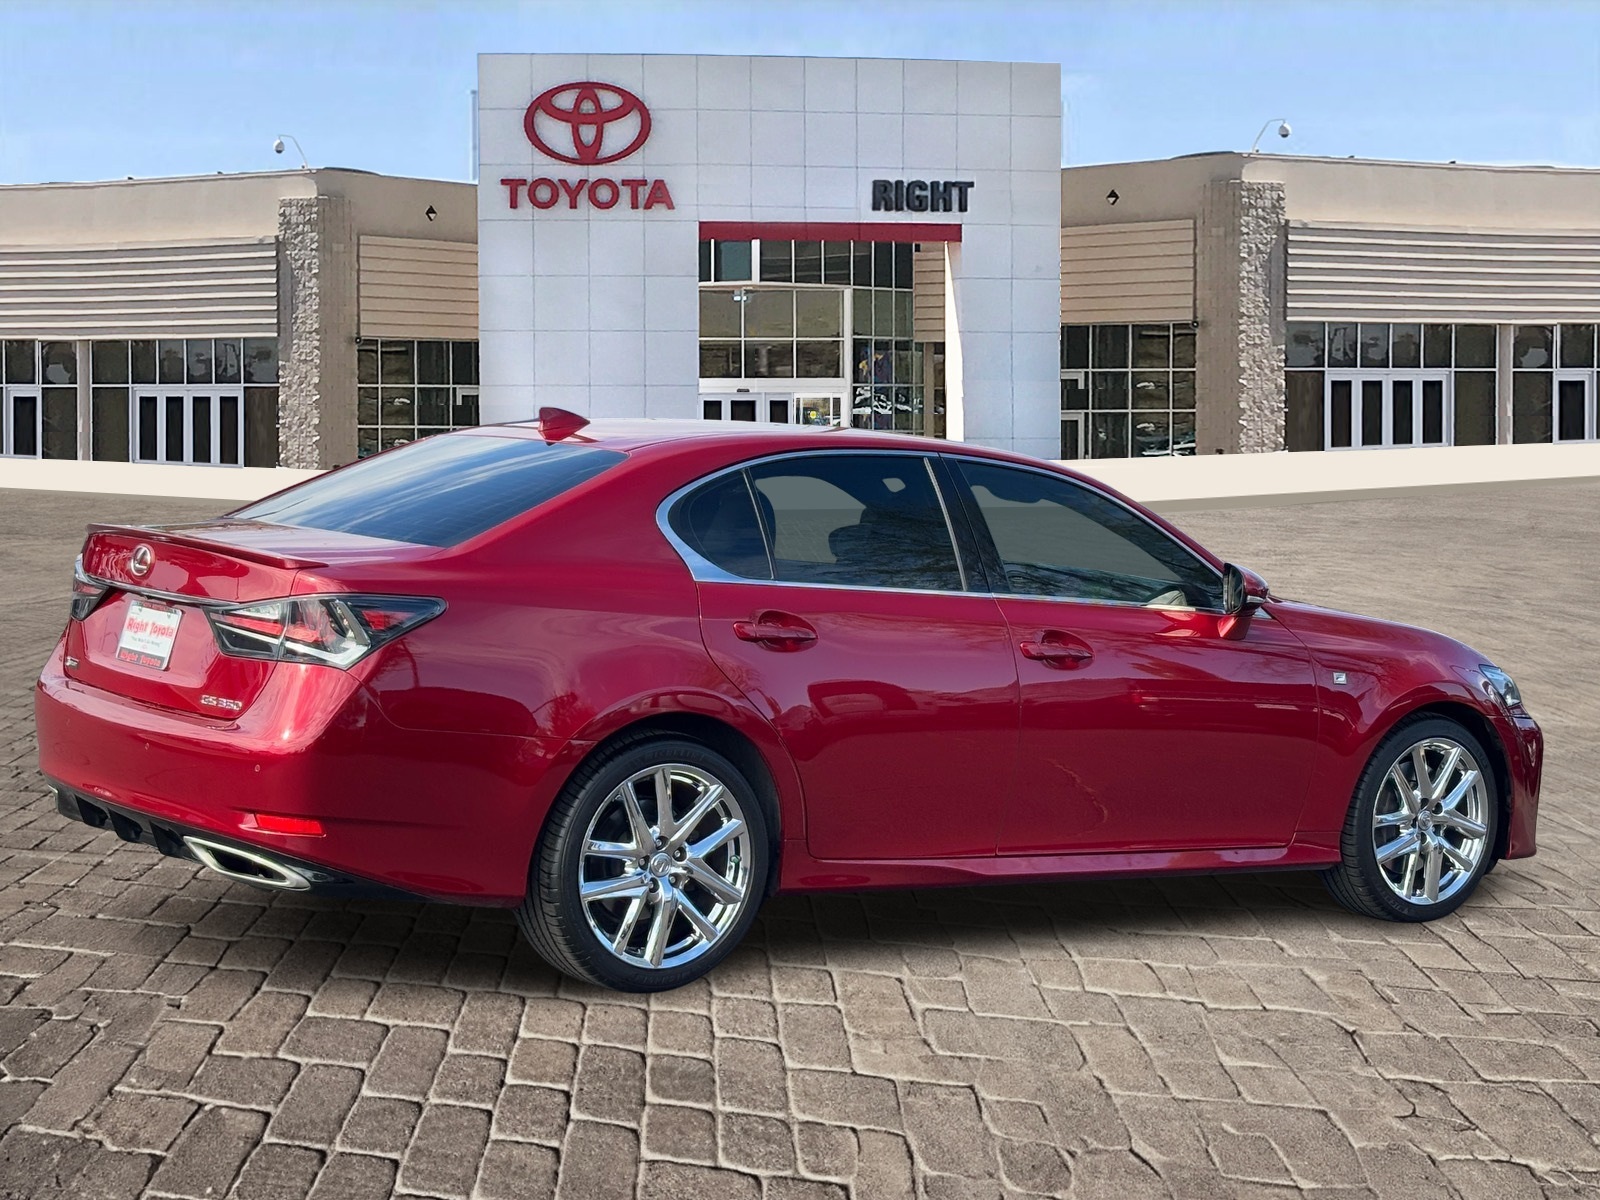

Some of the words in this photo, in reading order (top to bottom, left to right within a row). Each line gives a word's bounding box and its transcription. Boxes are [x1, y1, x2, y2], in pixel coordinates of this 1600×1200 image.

[500, 177, 675, 210] TOYOTA
[872, 179, 975, 212] RIGHT
[126, 616, 148, 634] Right
[150, 621, 175, 638] Toyota
